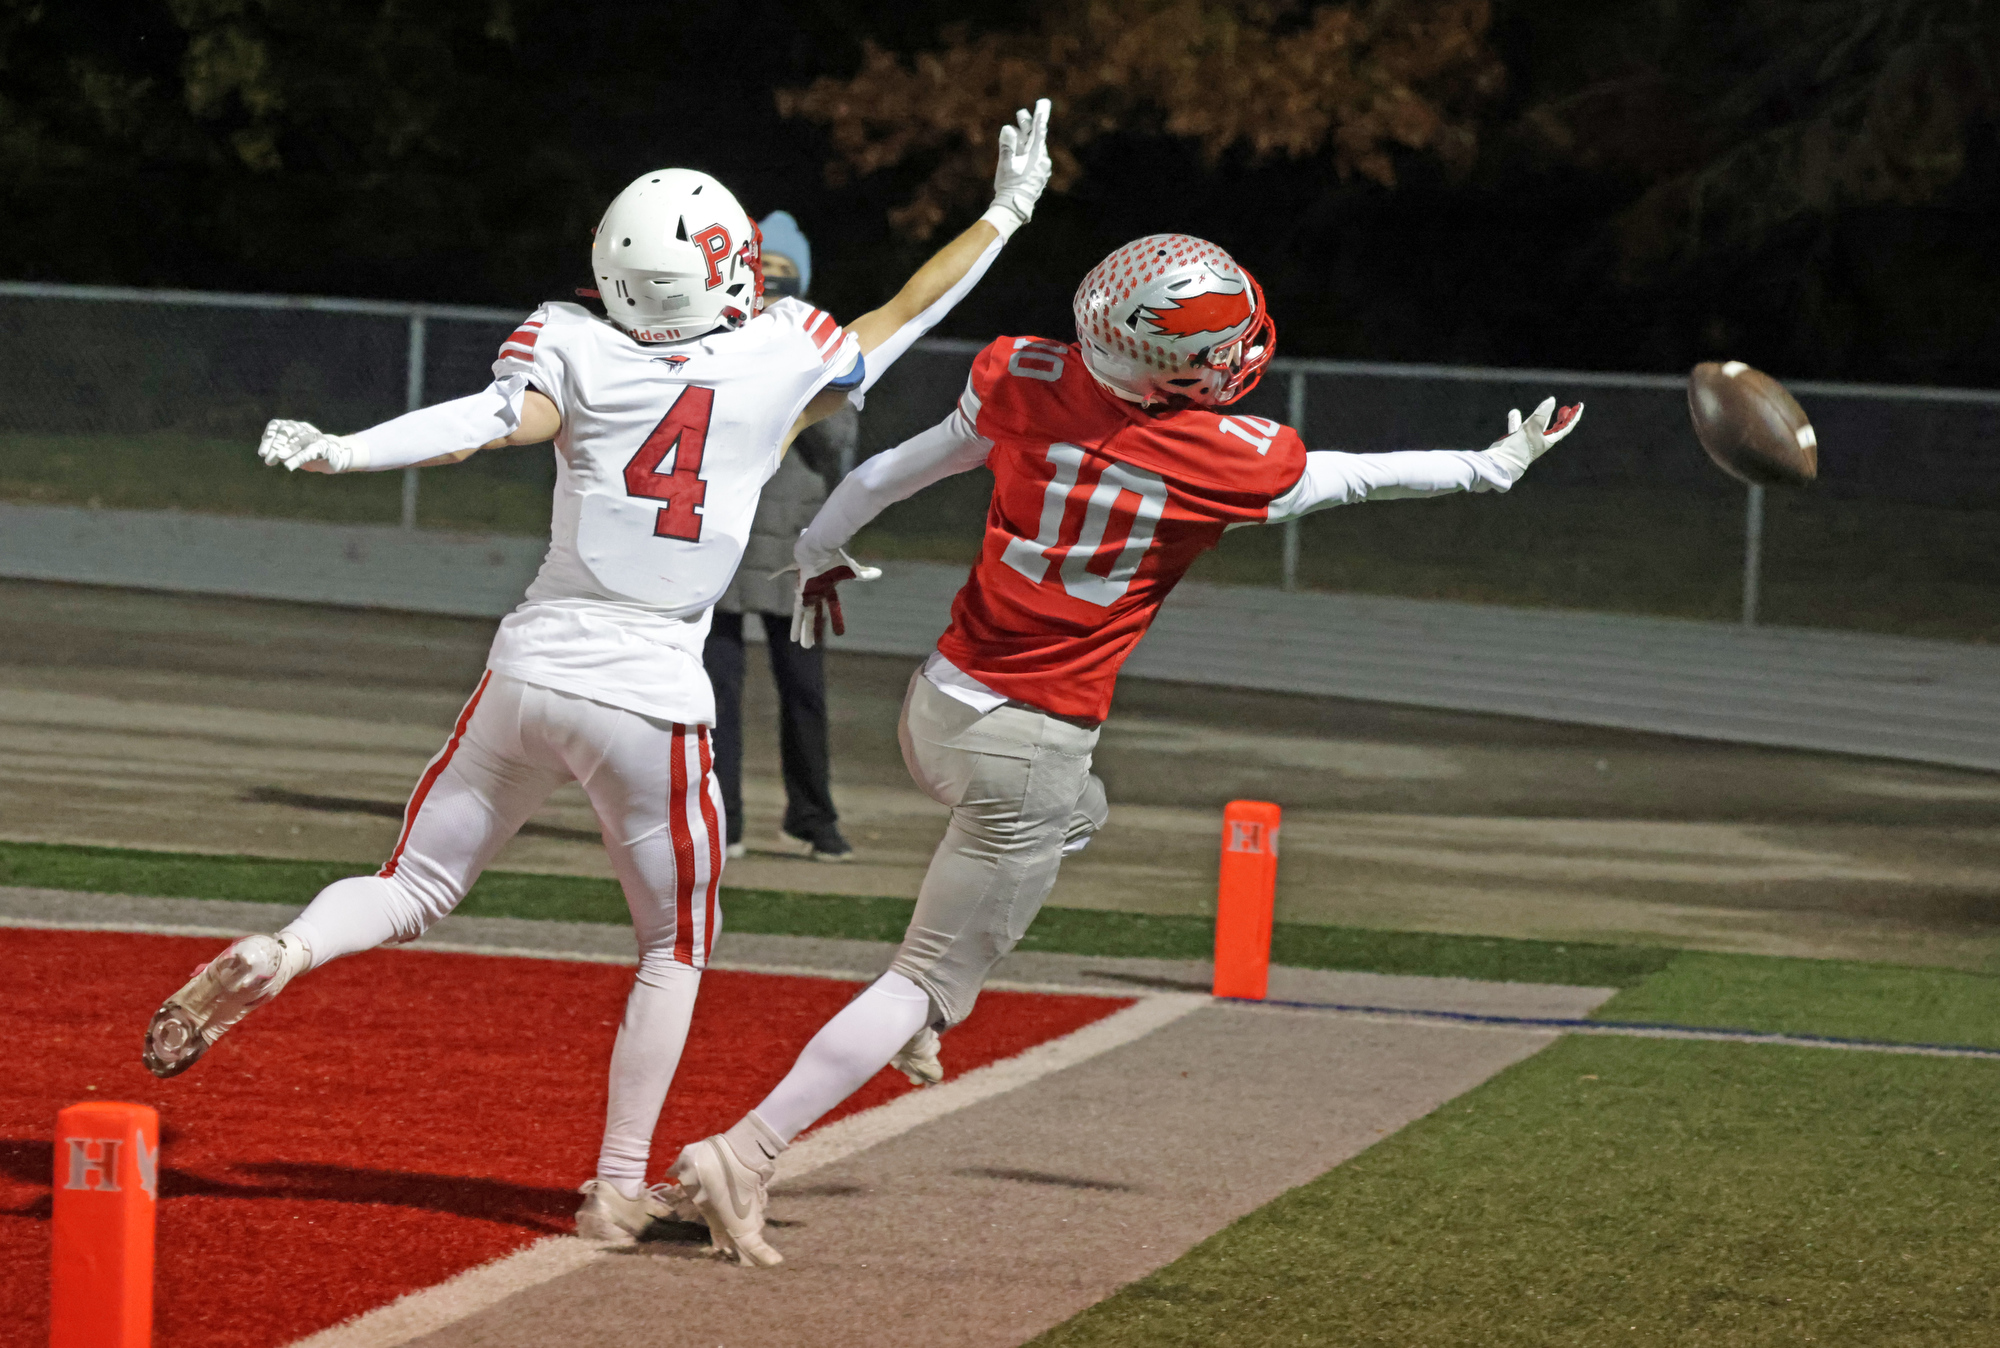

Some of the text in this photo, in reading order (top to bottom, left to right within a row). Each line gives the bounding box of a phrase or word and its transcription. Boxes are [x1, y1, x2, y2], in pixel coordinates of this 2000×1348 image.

[690, 222, 733, 291] P
[1008, 338, 1068, 382] 10
[623, 384, 715, 543] 4
[1000, 441, 1168, 608] 10
[63, 1137, 123, 1192] H
